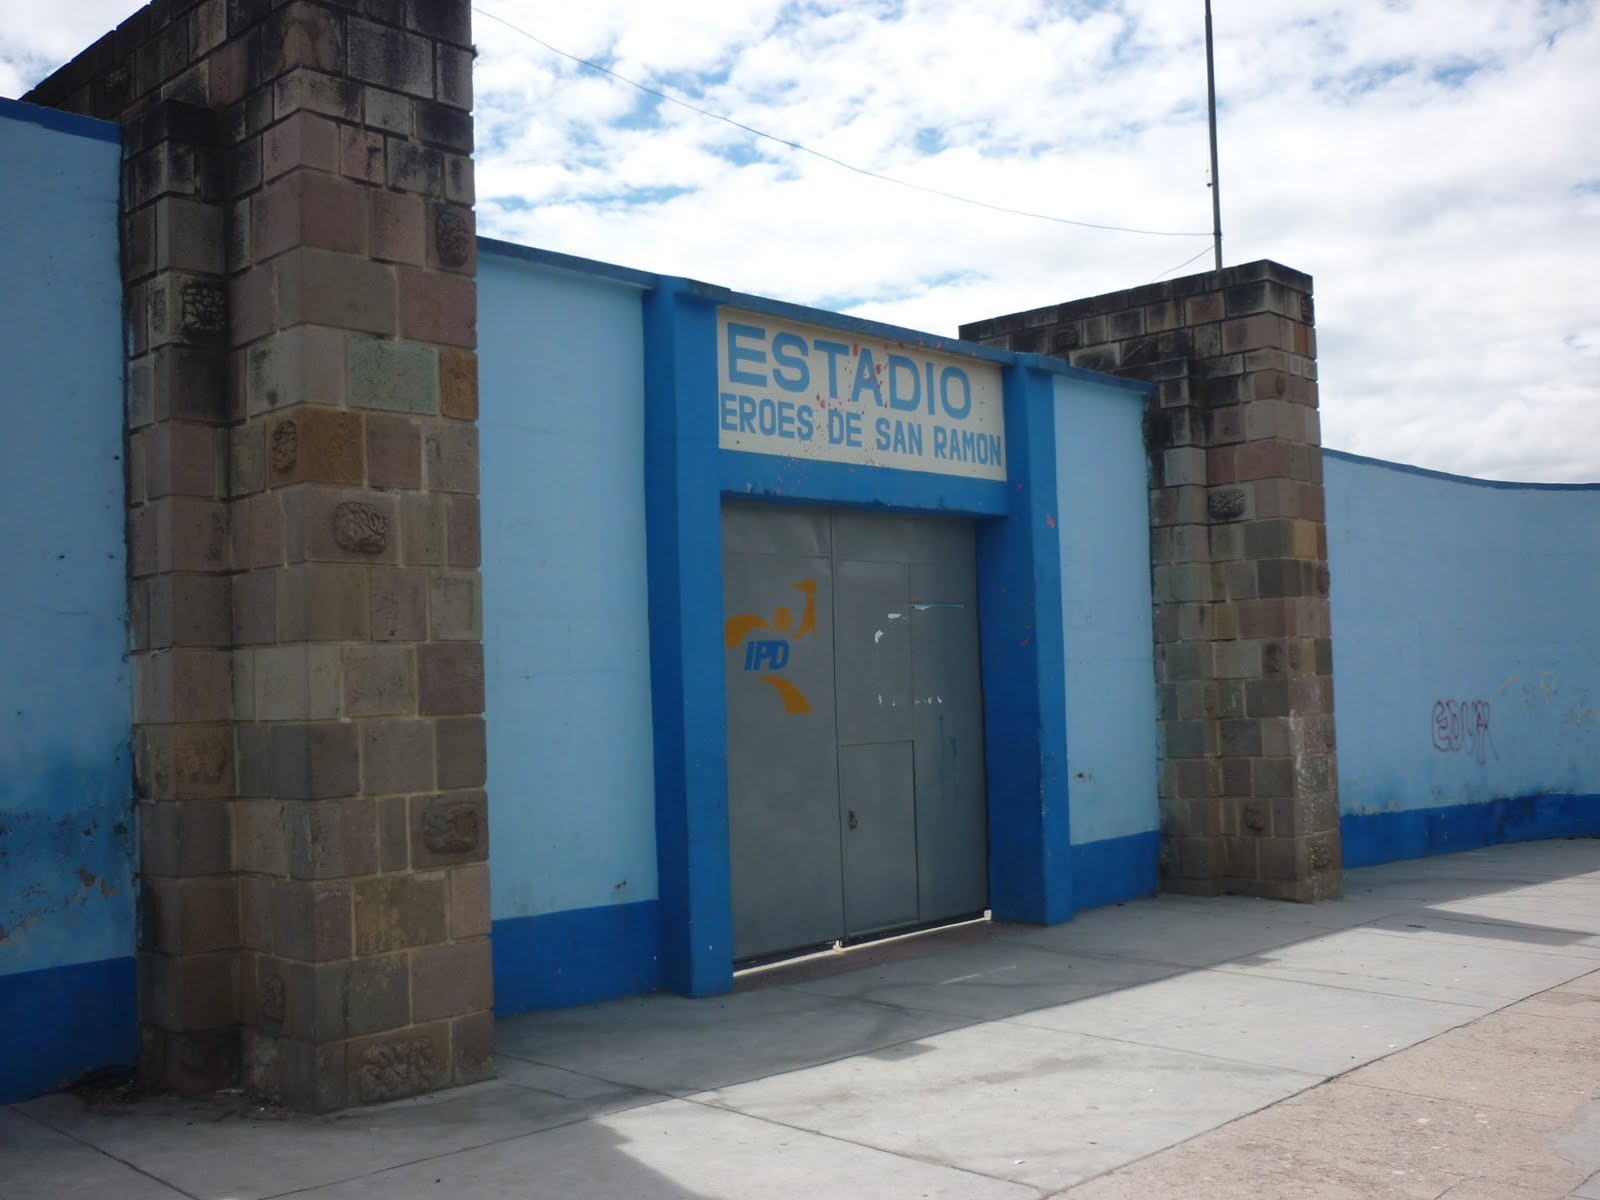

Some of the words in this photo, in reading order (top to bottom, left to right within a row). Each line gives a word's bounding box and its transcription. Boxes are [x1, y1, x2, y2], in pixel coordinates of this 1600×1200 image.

[726, 321, 972, 420] ESTADIO
[719, 392, 814, 442] EROES
[828, 408, 863, 448] DE
[875, 416, 923, 457] SAN
[933, 425, 1002, 467] RAMON
[744, 639, 790, 671] IPD
